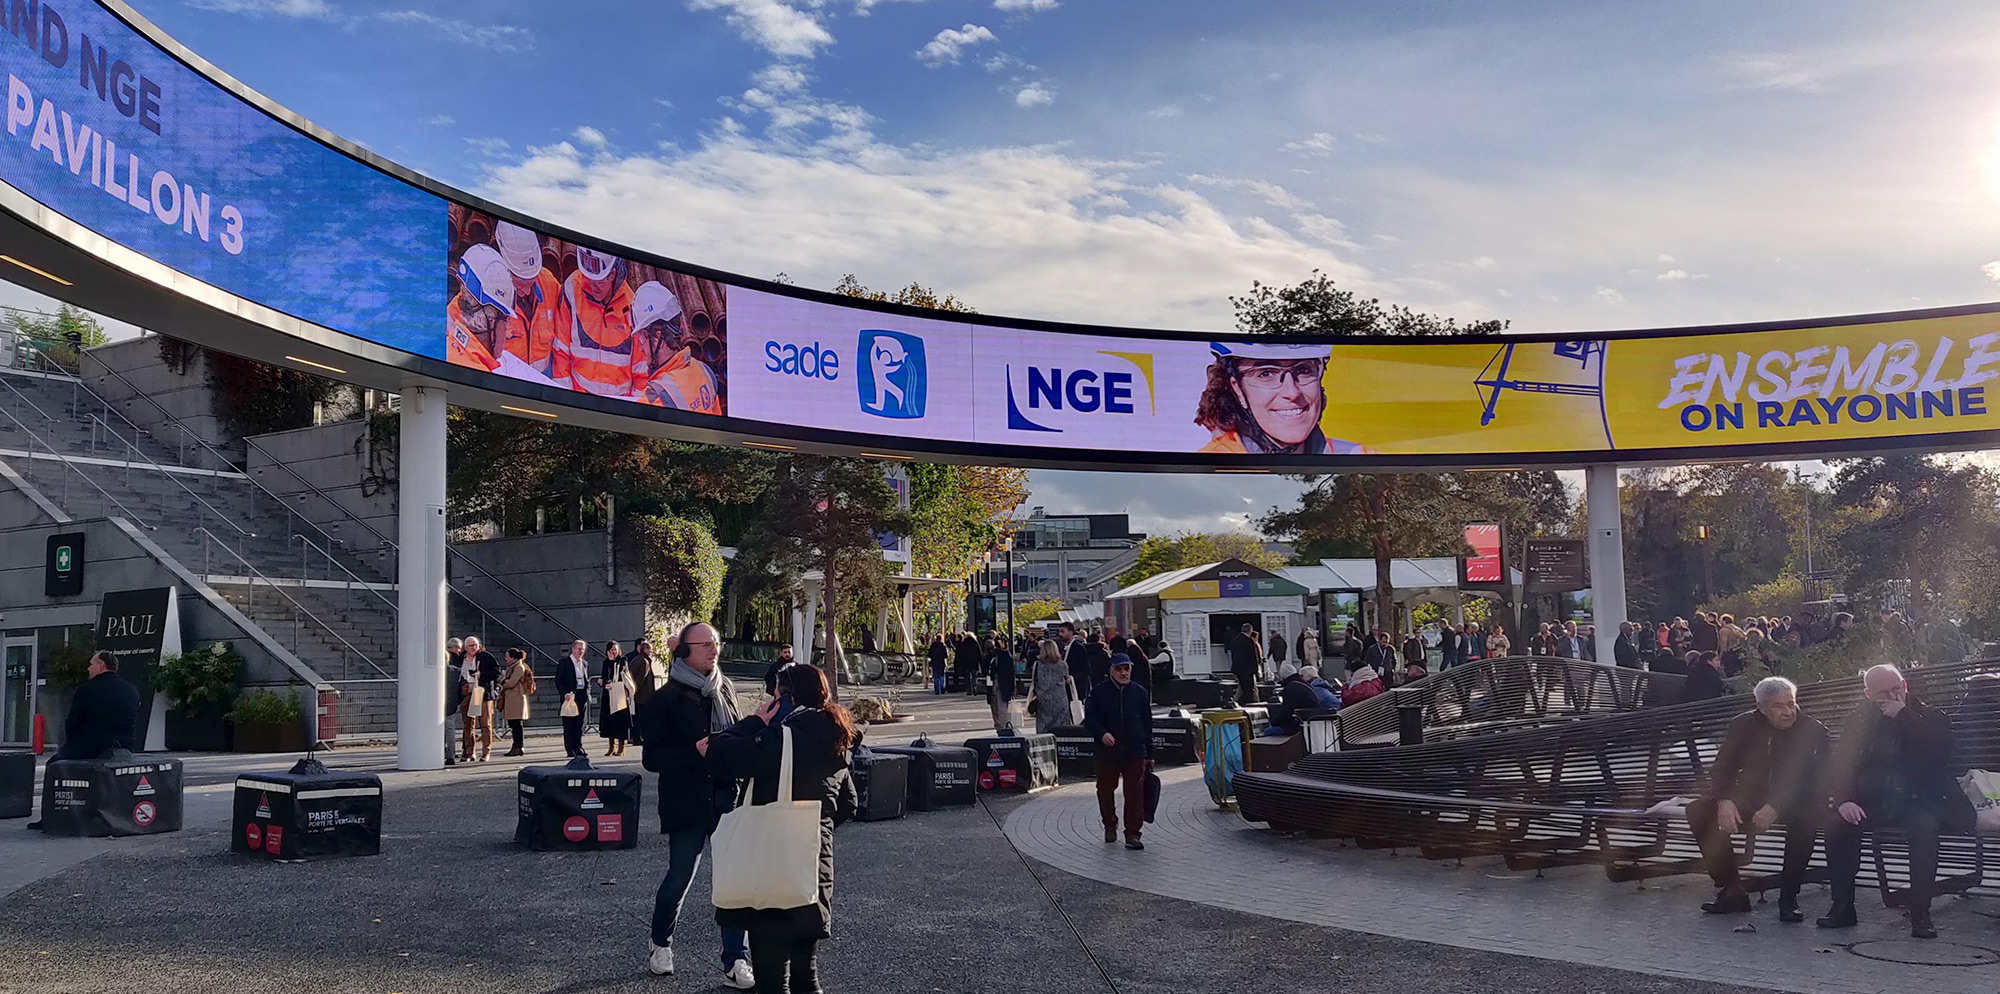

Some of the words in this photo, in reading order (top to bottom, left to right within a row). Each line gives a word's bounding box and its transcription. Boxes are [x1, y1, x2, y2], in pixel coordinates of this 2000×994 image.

[80, 33, 161, 136] NGE
[7, 73, 210, 242] PAVILLON
[220, 205, 244, 255] 3
[764, 340, 839, 381] sade
[1658, 332, 2000, 409] ENSEMBLE
[1027, 365, 1134, 414] NGE
[1680, 402, 1744, 432] ON
[1757, 386, 1987, 428] RAYONNE
[1218, 570, 1250, 578] Bagagerie
[105, 614, 157, 638] PAUL
[935, 772, 952, 780] PARIS
[55, 791, 71, 800] PARIS
[308, 810, 333, 821] PARIS
[308, 820, 326, 828] PORTE
